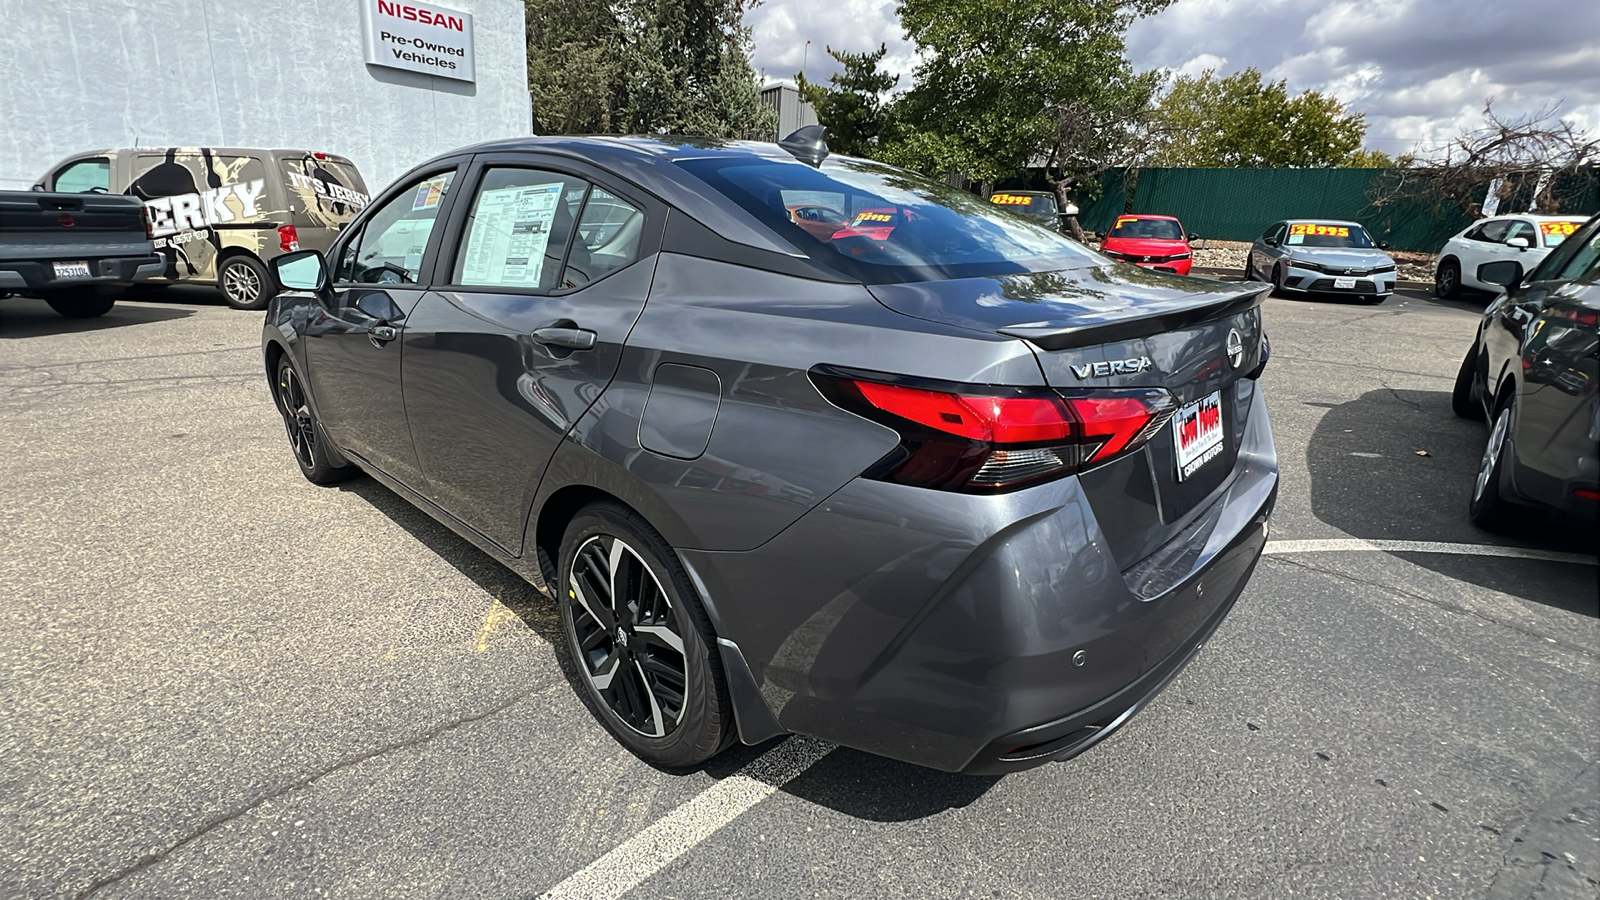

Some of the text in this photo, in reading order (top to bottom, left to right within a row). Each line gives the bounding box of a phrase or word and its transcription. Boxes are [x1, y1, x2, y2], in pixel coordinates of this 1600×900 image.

[378, 0, 463, 32] NISSAN
[381, 31, 465, 57] Pre-Owned
[392, 48, 457, 70] Vehicles
[287, 171, 369, 209] IT'S JERKY
[144, 178, 264, 237] ERKY
[173, 233, 192, 244] EST
[1069, 356, 1152, 380] VERSA
[1184, 455, 1204, 477] CROWN
[1203, 442, 1224, 462] MOTORS
